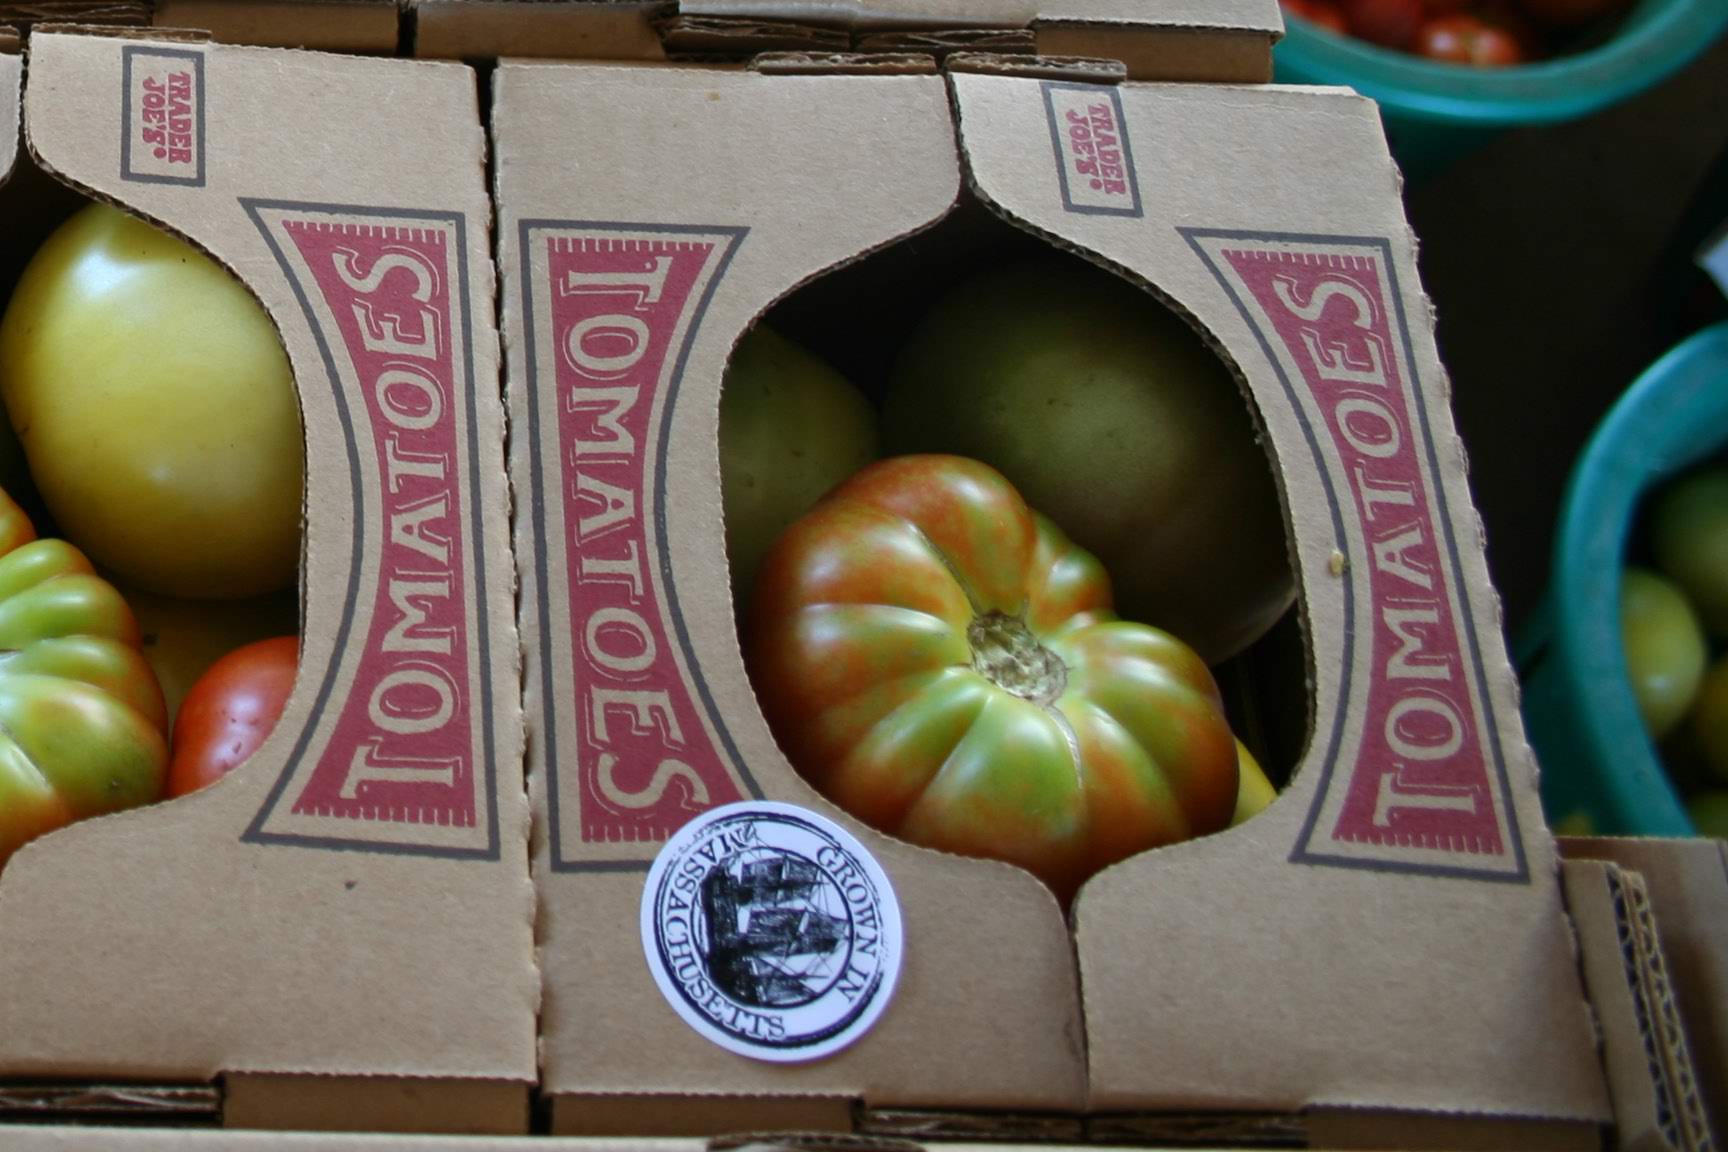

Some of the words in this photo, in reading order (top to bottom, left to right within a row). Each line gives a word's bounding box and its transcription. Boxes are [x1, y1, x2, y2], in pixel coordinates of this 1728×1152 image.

[168, 72, 191, 164] TRADER
[1088, 104, 1126, 194] TRADER
[334, 245, 462, 801] TOMATOES
[558, 255, 710, 818] TOMATOES
[1274, 274, 1478, 828] TOMATOES
[666, 823, 786, 1038] MASSACHUSETTS
[817, 845, 877, 957] GROWN
[837, 963, 870, 1003] IN
